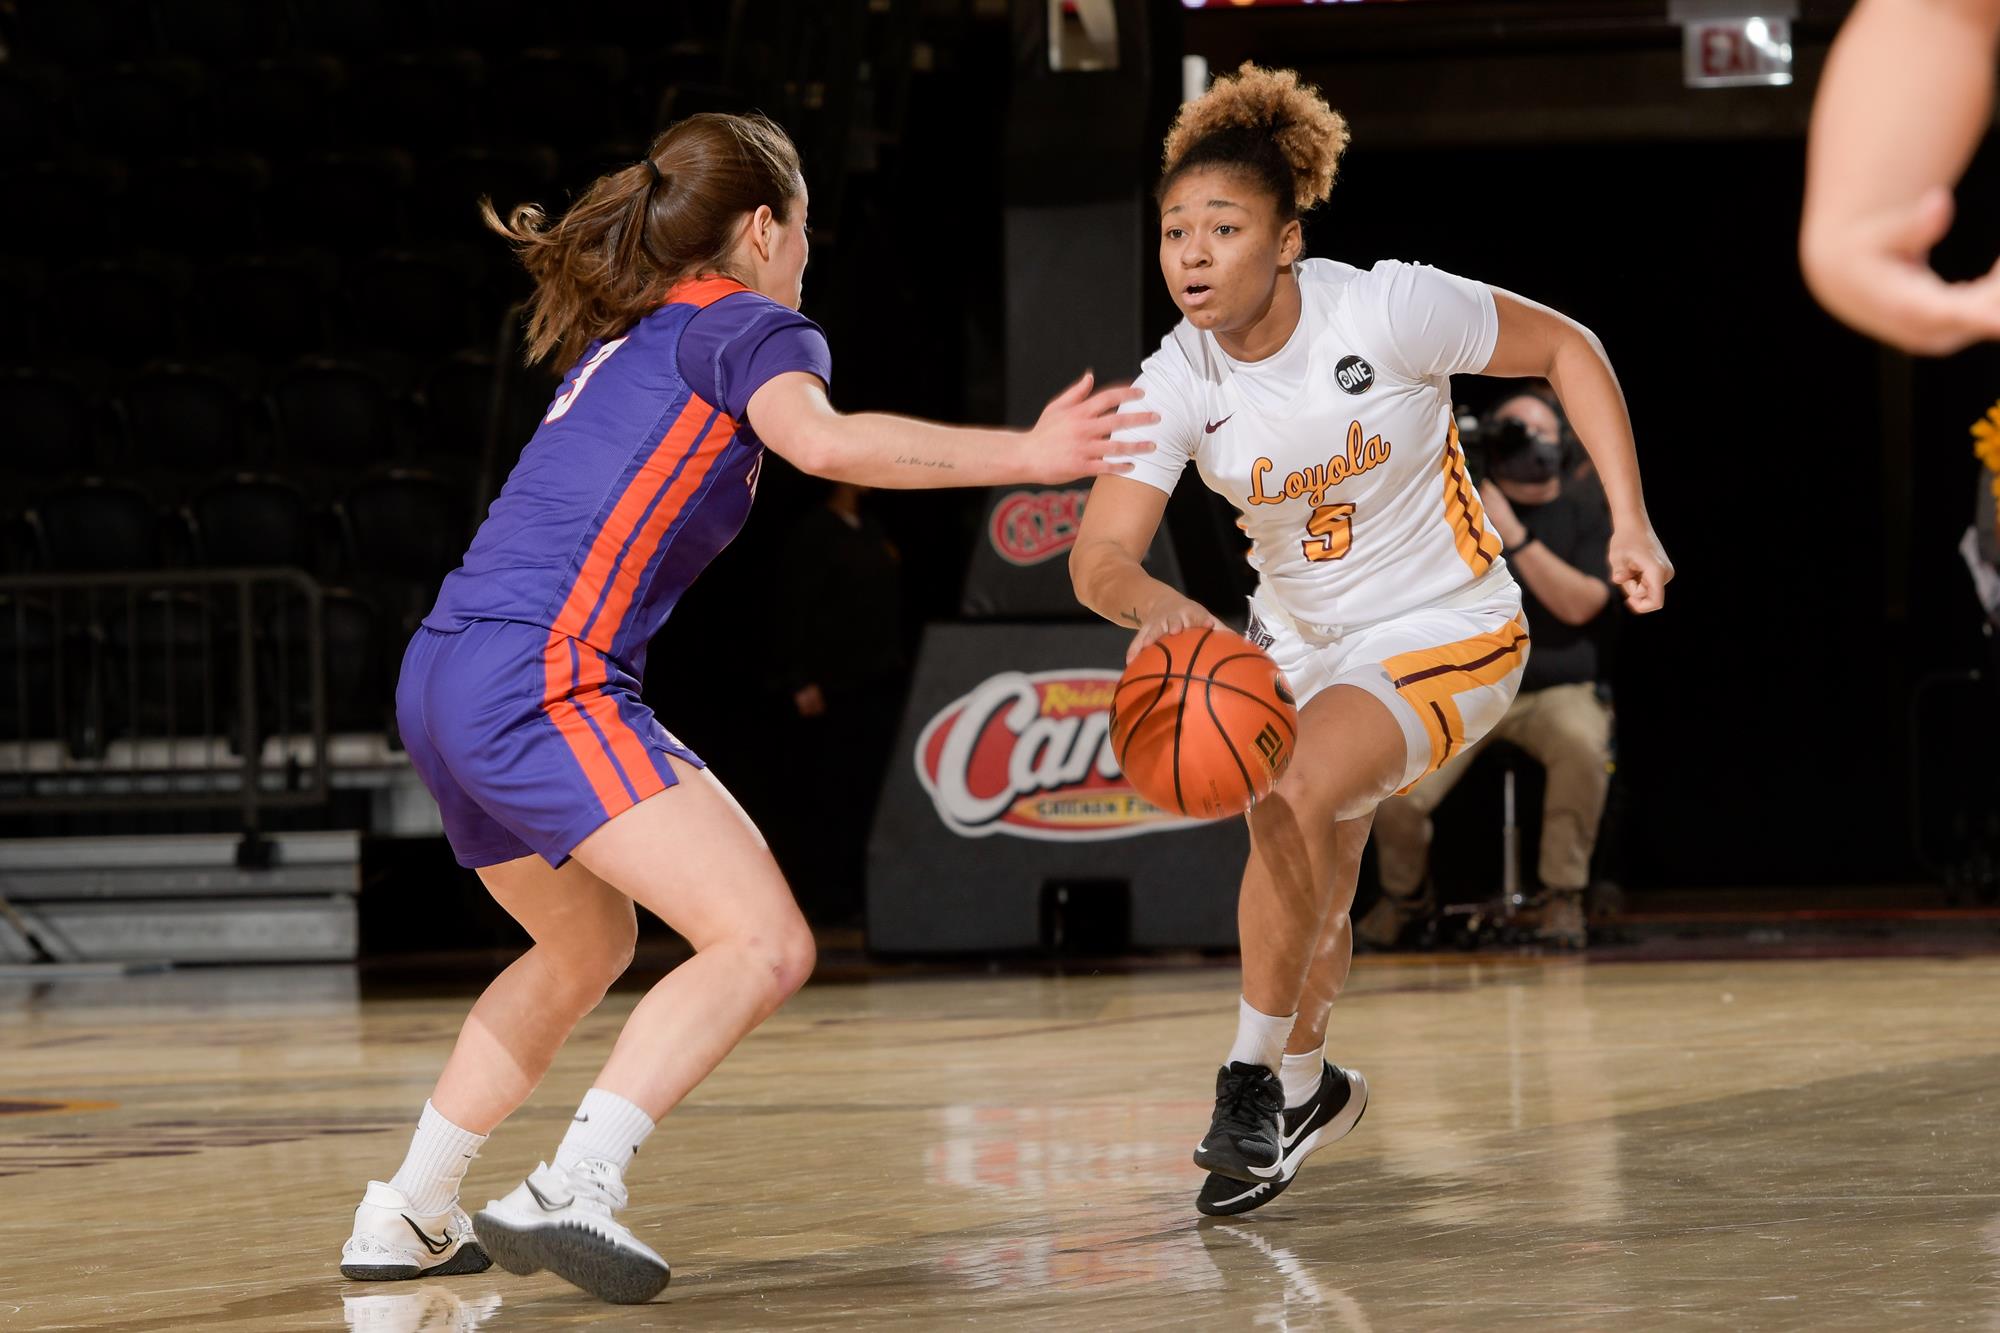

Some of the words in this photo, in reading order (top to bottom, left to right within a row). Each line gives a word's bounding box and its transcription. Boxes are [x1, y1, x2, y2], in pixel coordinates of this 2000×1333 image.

[1338, 361, 1371, 389] ONE
[1248, 420, 1391, 507] Loyola
[1302, 503, 1356, 562] 5
[936, 671, 1124, 825] Can
